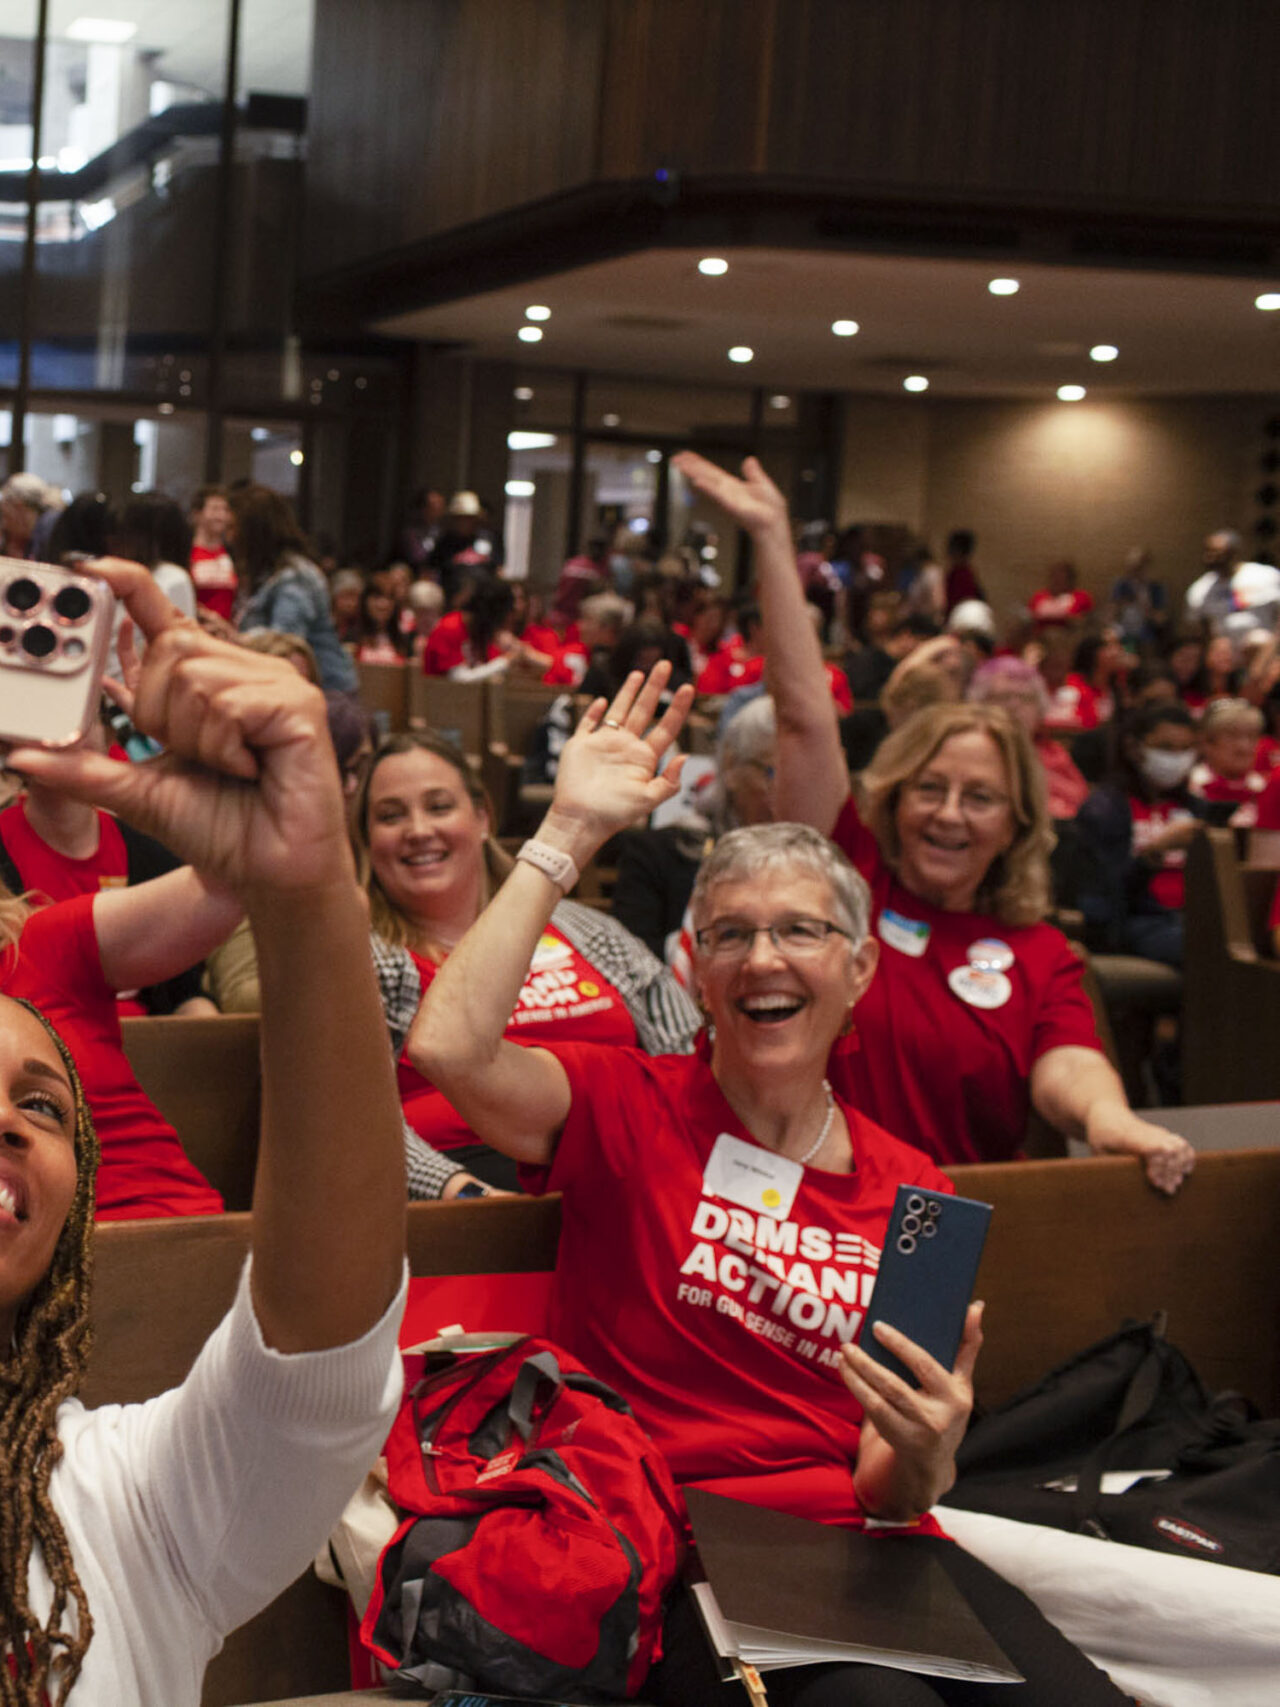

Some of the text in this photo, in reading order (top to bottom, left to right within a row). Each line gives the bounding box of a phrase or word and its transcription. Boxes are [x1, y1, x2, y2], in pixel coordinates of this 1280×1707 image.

[677, 1283, 713, 1308] FOR
[745, 1312, 796, 1348] SENSE
[796, 1338, 818, 1359] IN
[679, 1242, 863, 1343] ACTION
[1157, 1519, 1219, 1551] EASTPAK
